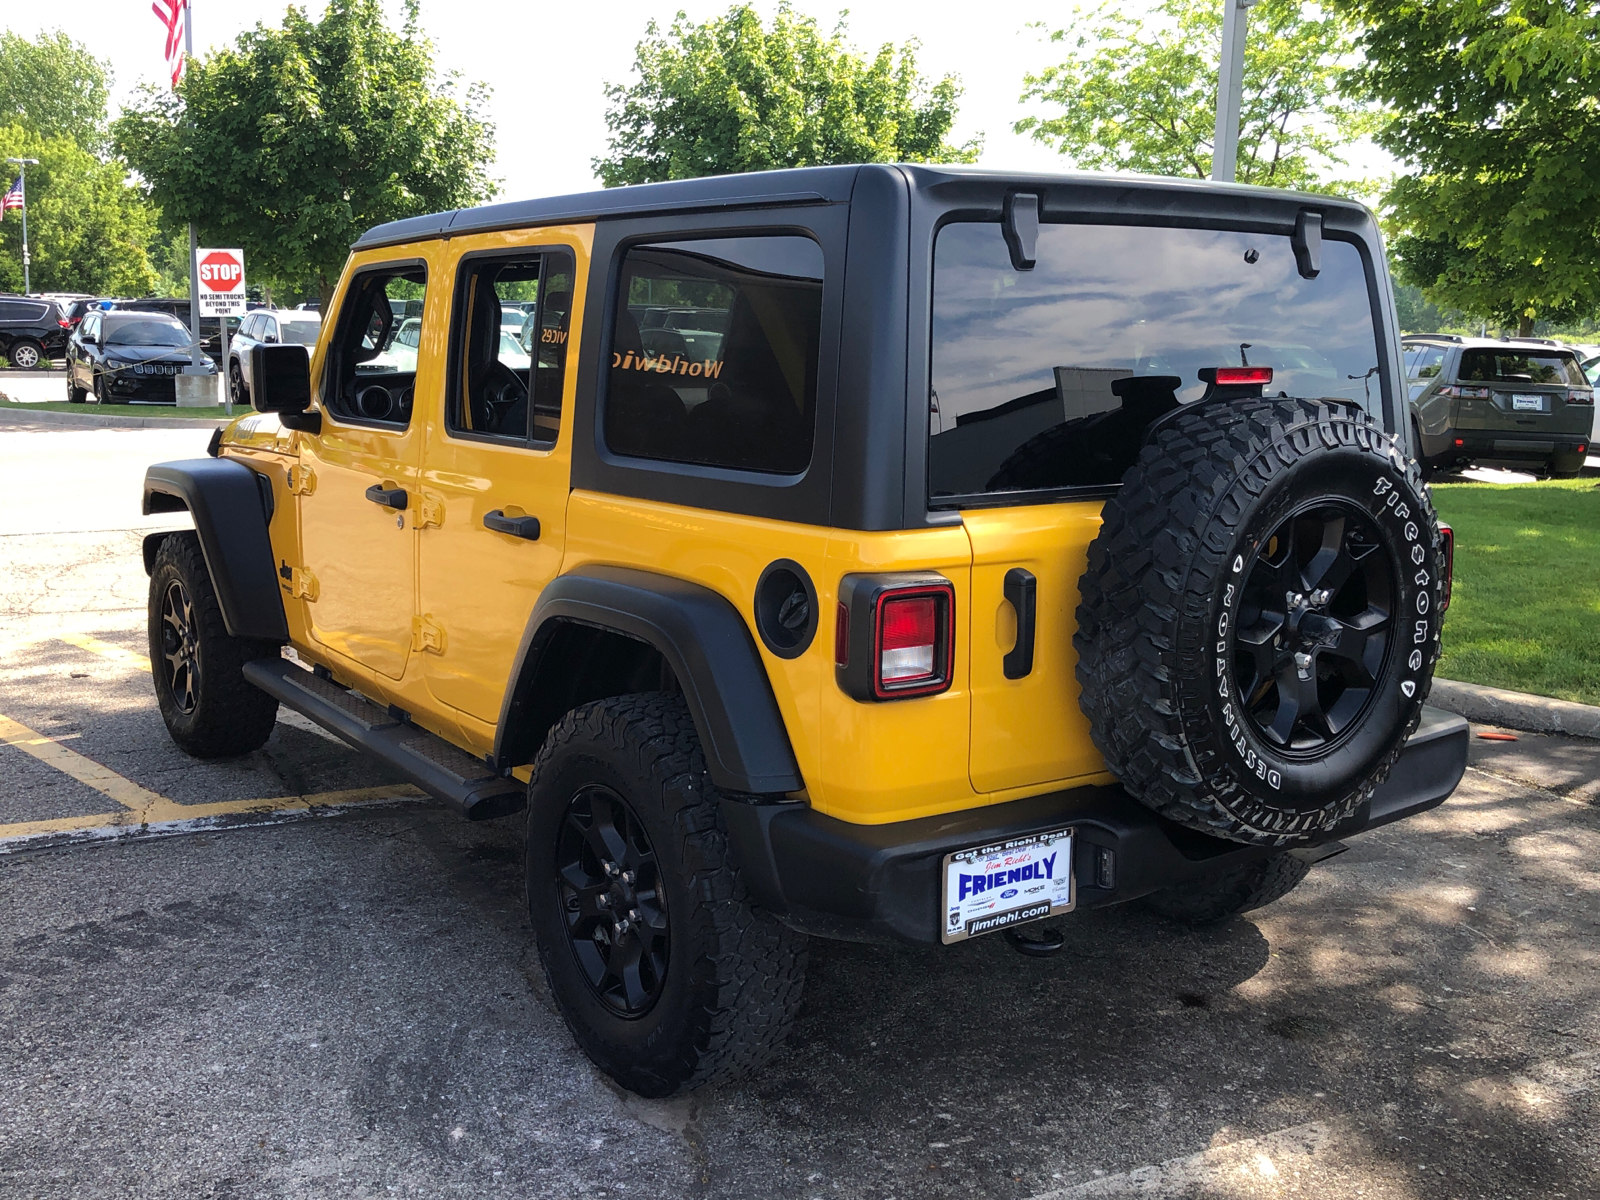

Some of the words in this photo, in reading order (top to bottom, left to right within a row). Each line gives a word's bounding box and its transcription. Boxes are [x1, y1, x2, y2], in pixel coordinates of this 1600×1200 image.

[201, 263, 240, 281] STOP
[1217, 583, 1281, 790] DESTINATION
[955, 849, 978, 861] Got
[981, 844, 1002, 855] the
[1005, 836, 1037, 851] Riehl
[1040, 830, 1068, 841] Deal
[958, 850, 1058, 903] FRIENDLY
[985, 861, 1002, 874] Jim
[1004, 852, 1032, 868] Riehl's
[970, 904, 1049, 935] jimriehl.com
